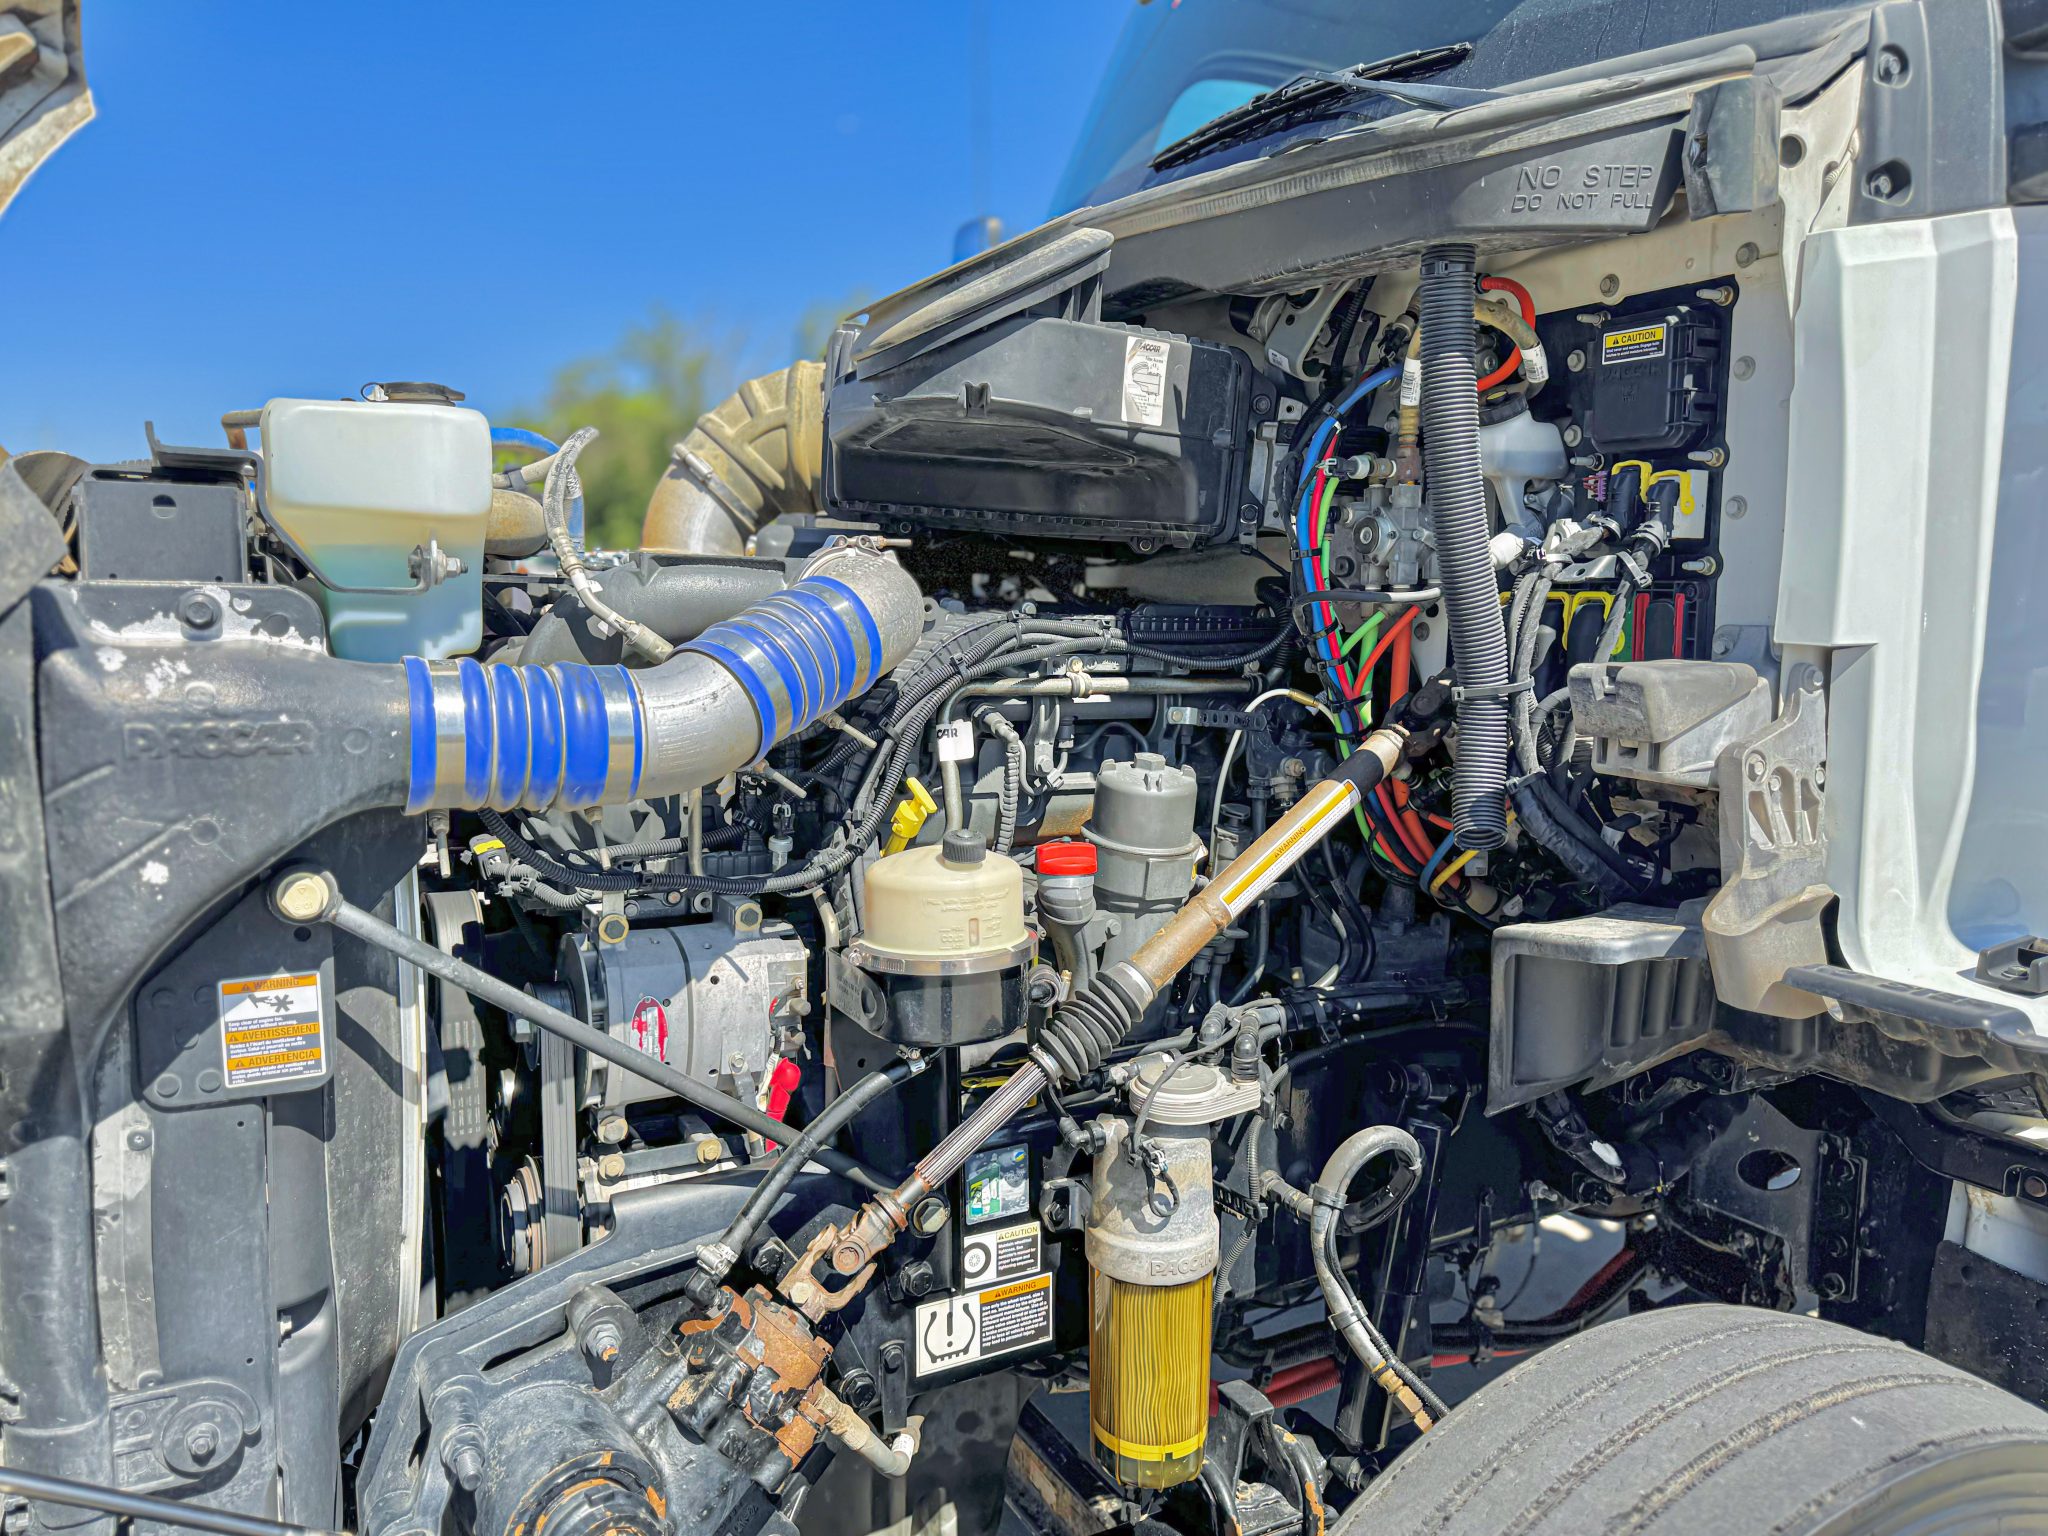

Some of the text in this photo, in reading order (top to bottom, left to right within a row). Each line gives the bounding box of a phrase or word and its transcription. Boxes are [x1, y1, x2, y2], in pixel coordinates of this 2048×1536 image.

[1517, 164, 1654, 191] NO STEP
[1510, 192, 1654, 213] DO NOT PULL
[1621, 331, 1656, 344] CAUTION
[1276, 825, 1306, 853] WARNING
[254, 976, 300, 991] WARNING
[242, 1024, 318, 1041] AVERTISSEMENT
[249, 1050, 315, 1066] ADVERTENCIA
[1004, 1226, 1038, 1239] CAUTION
[1150, 1248, 1216, 1277] PACCAR
[1002, 1281, 1036, 1296] WARNING
